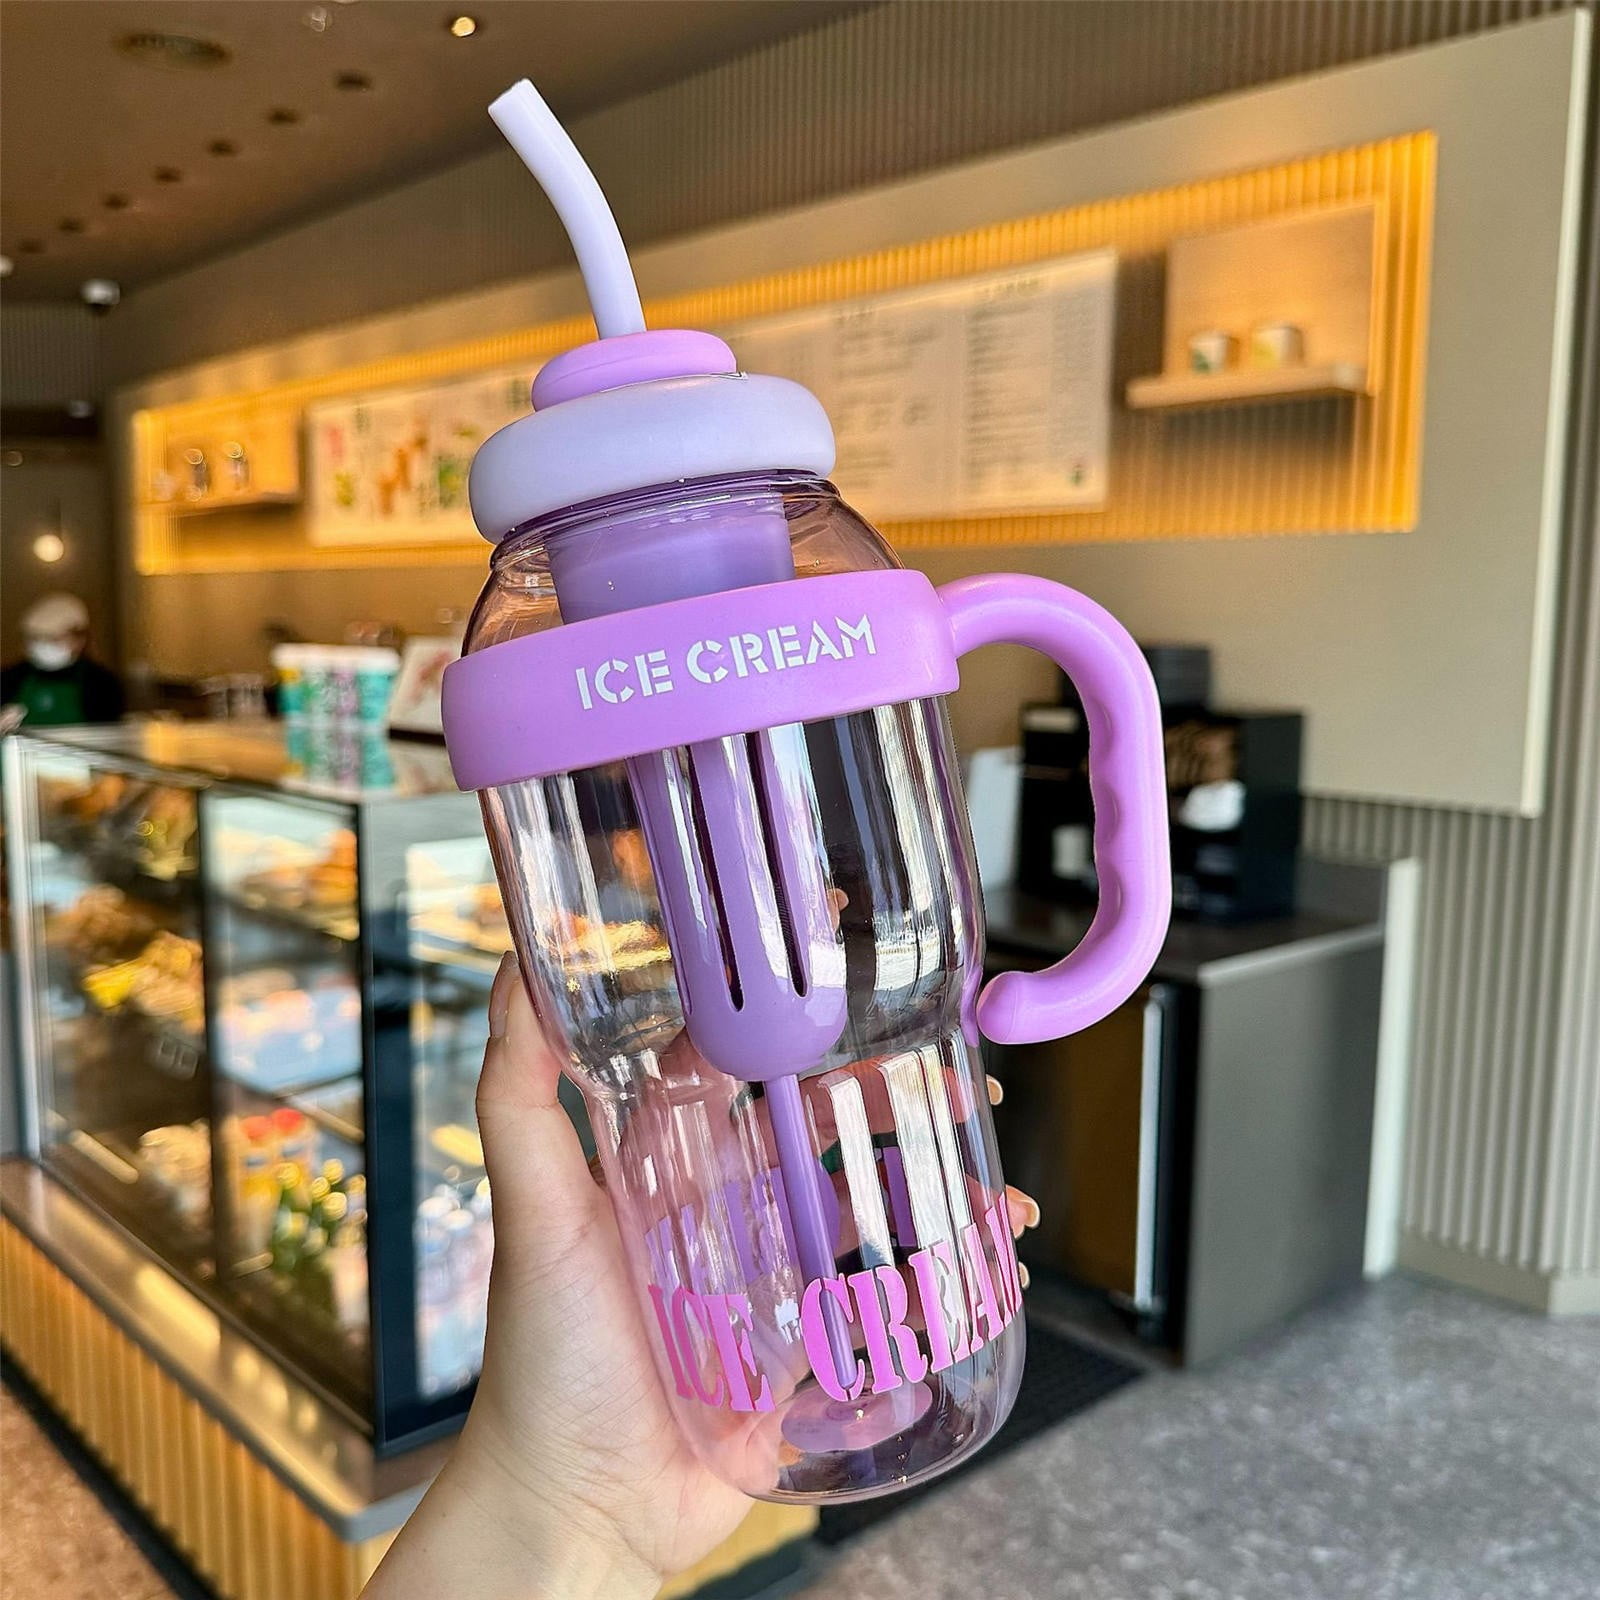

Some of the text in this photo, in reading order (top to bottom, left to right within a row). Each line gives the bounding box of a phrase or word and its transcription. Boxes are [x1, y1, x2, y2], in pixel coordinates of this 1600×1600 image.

[575, 613, 877, 710] ICE CREAM
[647, 1283, 777, 1412] ICE
